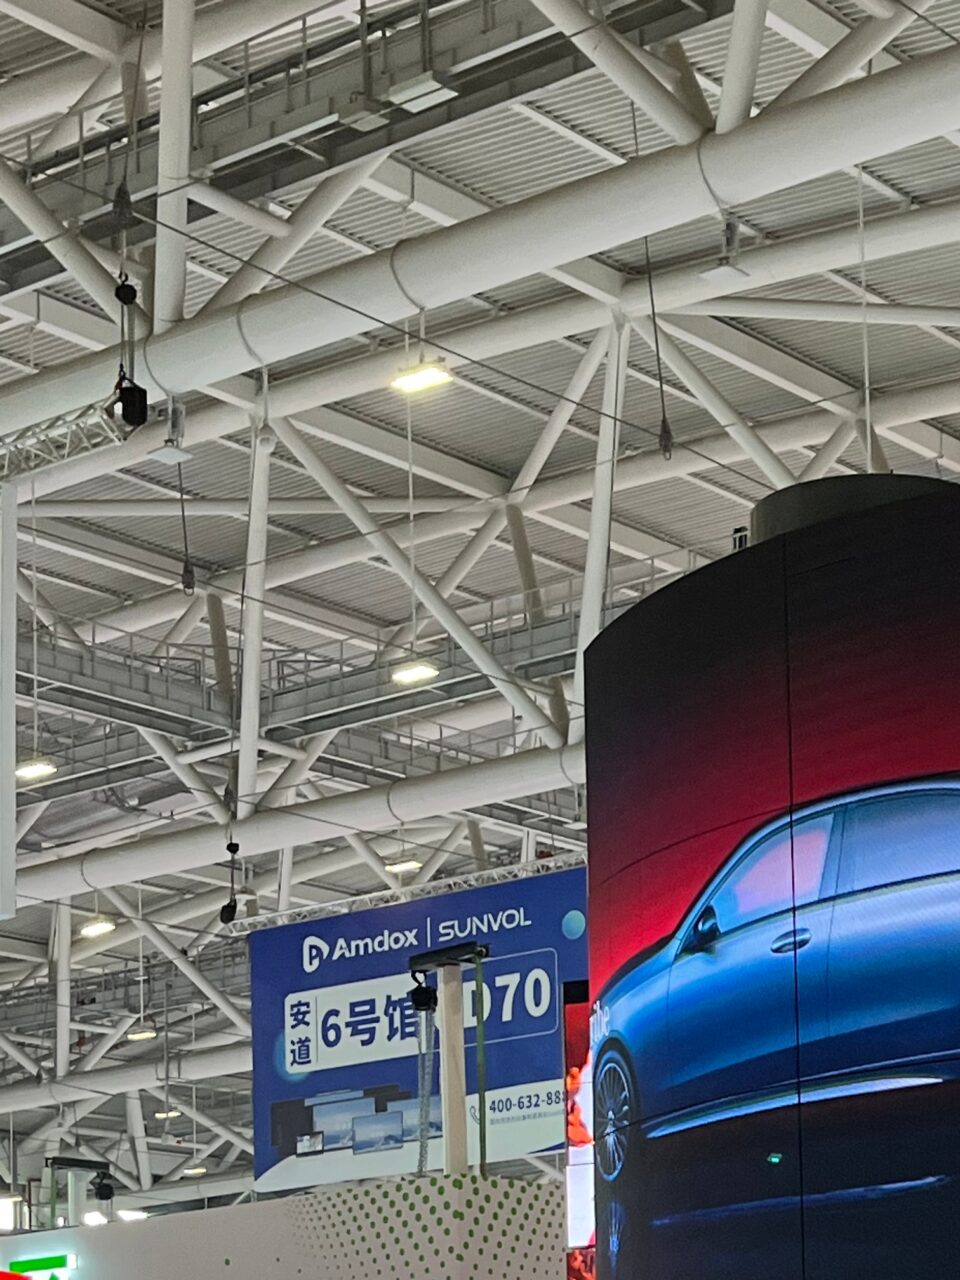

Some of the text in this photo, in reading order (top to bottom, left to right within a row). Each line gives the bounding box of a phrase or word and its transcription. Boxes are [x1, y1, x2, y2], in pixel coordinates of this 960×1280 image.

[332, 907, 532, 961] Amdox SUNVOL
[289, 1000, 312, 1067] 安道
[321, 994, 420, 1048] 6号馆
